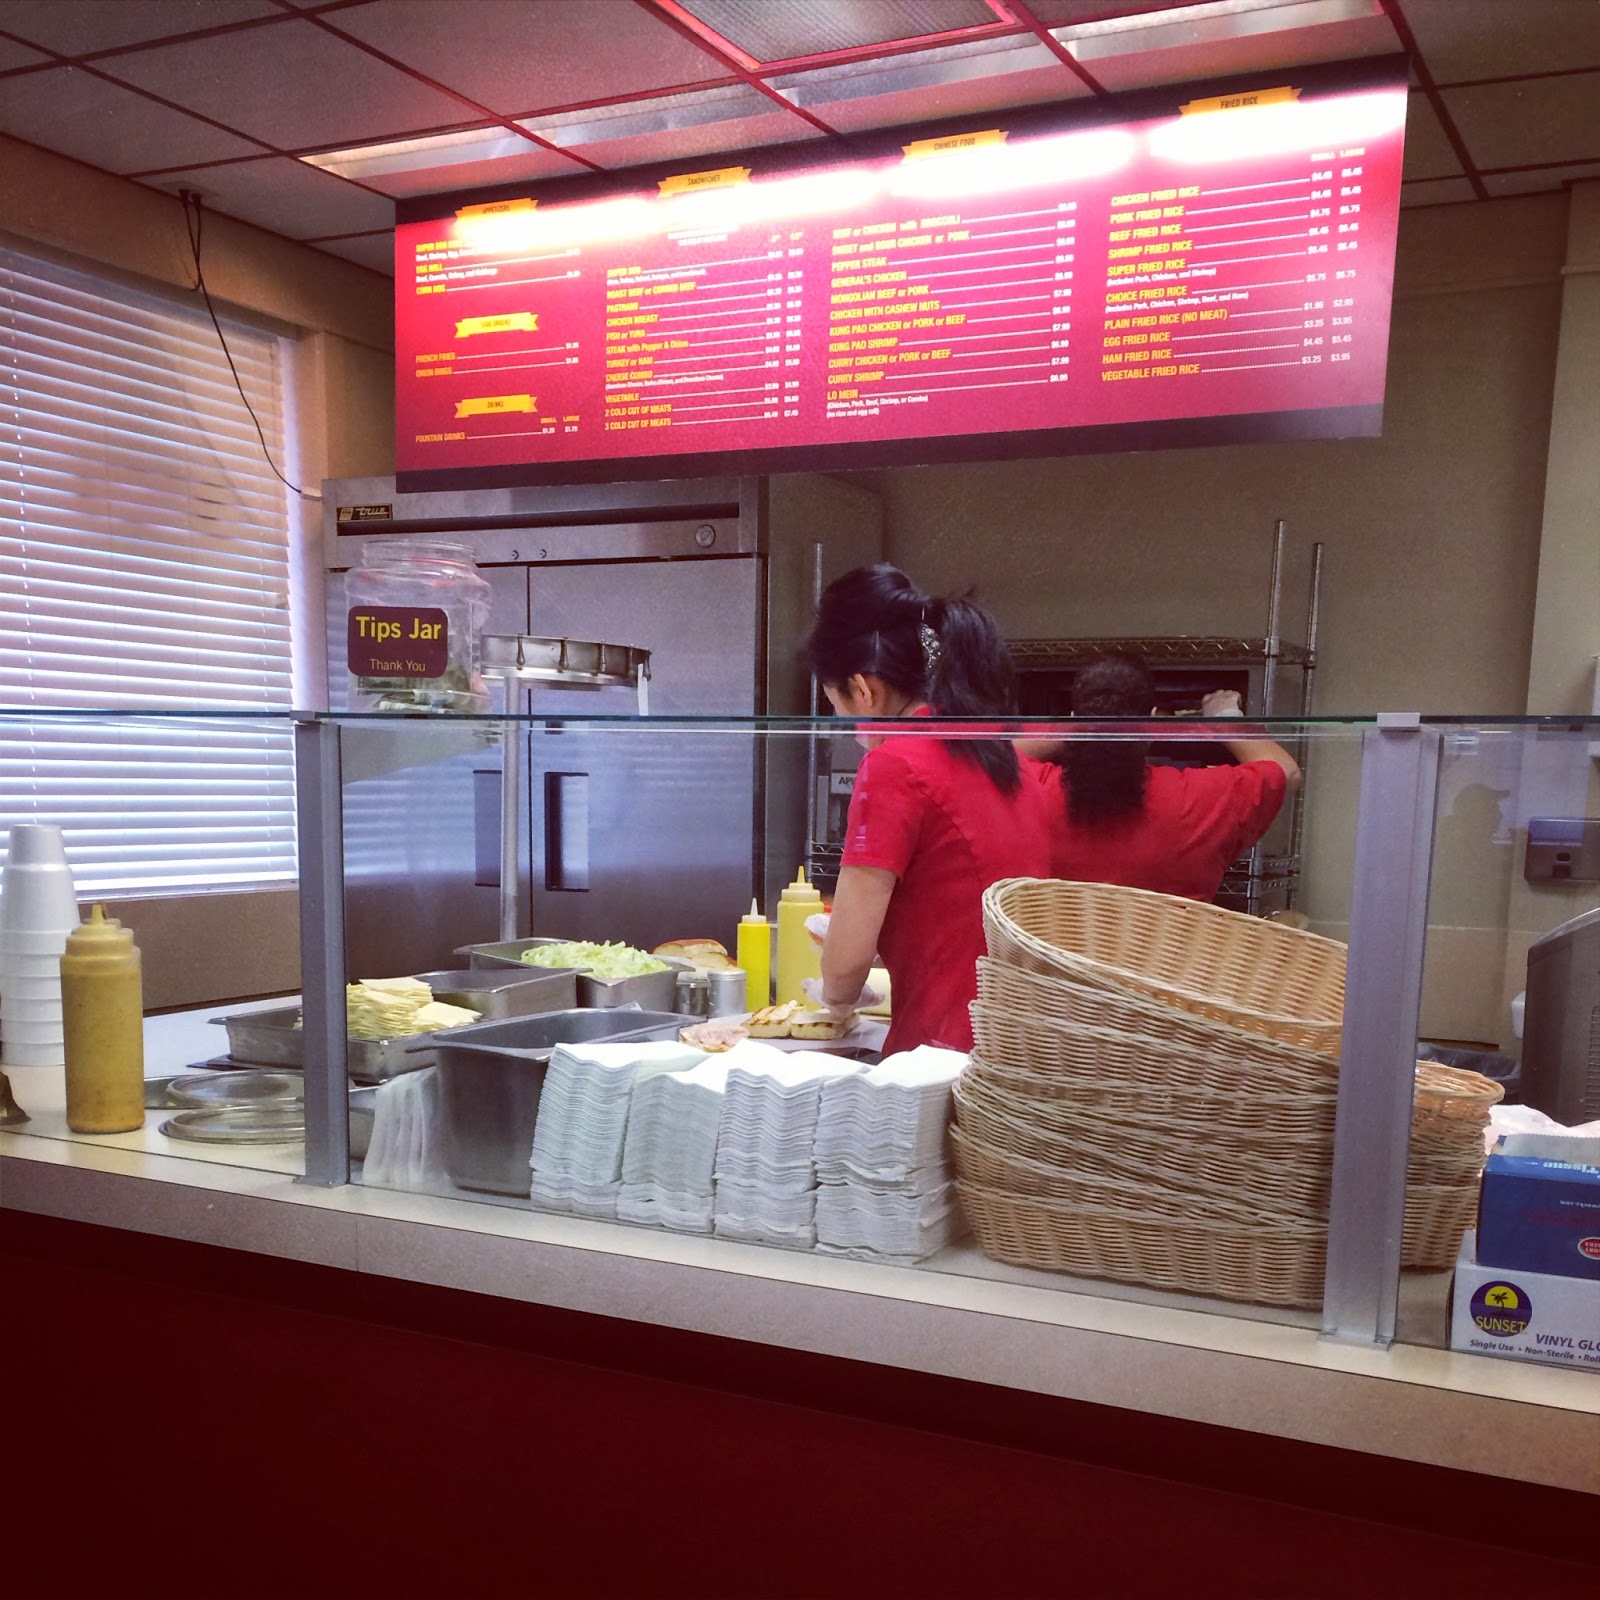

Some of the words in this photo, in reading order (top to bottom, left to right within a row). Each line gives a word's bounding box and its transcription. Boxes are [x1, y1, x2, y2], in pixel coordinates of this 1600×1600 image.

[1220, 98, 1240, 109] FRIED
[1242, 96, 1258, 105] RICE
[933, 140, 958, 151] CHINESE
[959, 137, 976, 147] FOOD
[687, 174, 720, 186] SANDWICHES
[1151, 189, 1177, 201] FRIED
[1178, 186, 1200, 198] RICE
[1110, 212, 1134, 224] PORK
[1136, 208, 1161, 221] FRIED
[1163, 206, 1184, 217] RICE
[1110, 230, 1131, 241] BEEF
[1133, 227, 1158, 238] FRIED
[1161, 224, 1181, 235] RICE
[1108, 246, 1143, 258] SHRIMP
[1144, 243, 1170, 254] FRIED
[1172, 240, 1192, 252] RICE
[832, 260, 860, 271] PEPPER
[862, 257, 886, 268] STEAK
[1108, 265, 1135, 276] SUPER
[1138, 261, 1163, 272] FRIED
[1165, 259, 1185, 270] RICE
[831, 275, 872, 288] GENERAL'S
[873, 271, 906, 283] CHICKEN
[831, 291, 875, 304] MONGOLIAN
[877, 289, 896, 299] BEEF
[908, 285, 928, 295] PORK
[1106, 291, 1137, 303] CHOICE
[1139, 288, 1164, 299] FRIED
[1167, 286, 1187, 296] RICE
[830, 309, 862, 320] CHICKEN
[864, 306, 883, 317] WITH
[885, 303, 918, 315] CASHEW
[919, 300, 940, 311] NUTS
[1304, 301, 1324, 310] $1.95
[1333, 298, 1354, 307] $2.95
[829, 326, 850, 336] KUNG
[852, 324, 867, 334] PAO
[868, 321, 902, 333] CHICKEN
[913, 317, 934, 328] PORK
[946, 314, 966, 325] BEEF
[1104, 318, 1130, 330] PLAIN
[1132, 316, 1157, 327] FRIED
[1159, 313, 1180, 325] RICE
[1182, 312, 1197, 324] (NO
[1200, 309, 1228, 321] MEAT)
[1304, 319, 1324, 328] $3.25
[1332, 316, 1353, 325] $3.95
[829, 342, 850, 352] KUNG
[851, 340, 867, 350] PAO
[868, 337, 898, 349] SHRIMP
[1104, 337, 1120, 347] EGG
[1123, 334, 1148, 345] FRIED
[1150, 332, 1170, 343] RICE
[1303, 337, 1323, 346] $4.45
[1332, 335, 1352, 344] $5.45
[828, 358, 854, 368] CURRY
[855, 355, 888, 366] CHICKEN
[889, 355, 897, 363] or
[899, 351, 920, 362] PORK
[921, 352, 930, 360] or
[931, 349, 951, 359] BEEF
[1103, 353, 1123, 364] HAM
[1124, 351, 1149, 362] FRIED
[1152, 349, 1172, 360] RICE
[1302, 355, 1322, 364] $3.25
[1331, 353, 1351, 362] $3.95
[828, 374, 853, 384] CURRY
[854, 371, 884, 382] SHRIMP
[1102, 368, 1149, 381] VEGETABLE
[1152, 366, 1177, 376] FRIED
[1179, 364, 1200, 374] RICE
[605, 393, 639, 403] VEGETABLE
[827, 391, 837, 400] LO
[839, 389, 858, 399] MEIN
[487, 401, 504, 409] DRINKS
[605, 409, 609, 417] 2
[610, 408, 626, 416] COLD
[628, 406, 640, 415] CUT
[650, 404, 672, 413] MEATS
[610, 421, 626, 429] COLD
[627, 420, 640, 428] CUT
[650, 418, 671, 426] MEATS
[416, 434, 443, 443] FOUNTAIN
[444, 432, 465, 441] DRINKS
[355, 616, 402, 643] Tips
[408, 617, 442, 640] Jar
[370, 658, 402, 671] Thank
[406, 660, 426, 672] You
[1476, 1315, 1527, 1334] SUNSET
[1535, 1333, 1575, 1349] VINYL
[1470, 1339, 1497, 1350] Single
[1498, 1342, 1514, 1352] Use
[1524, 1346, 1575, 1360] Non-Sterile
